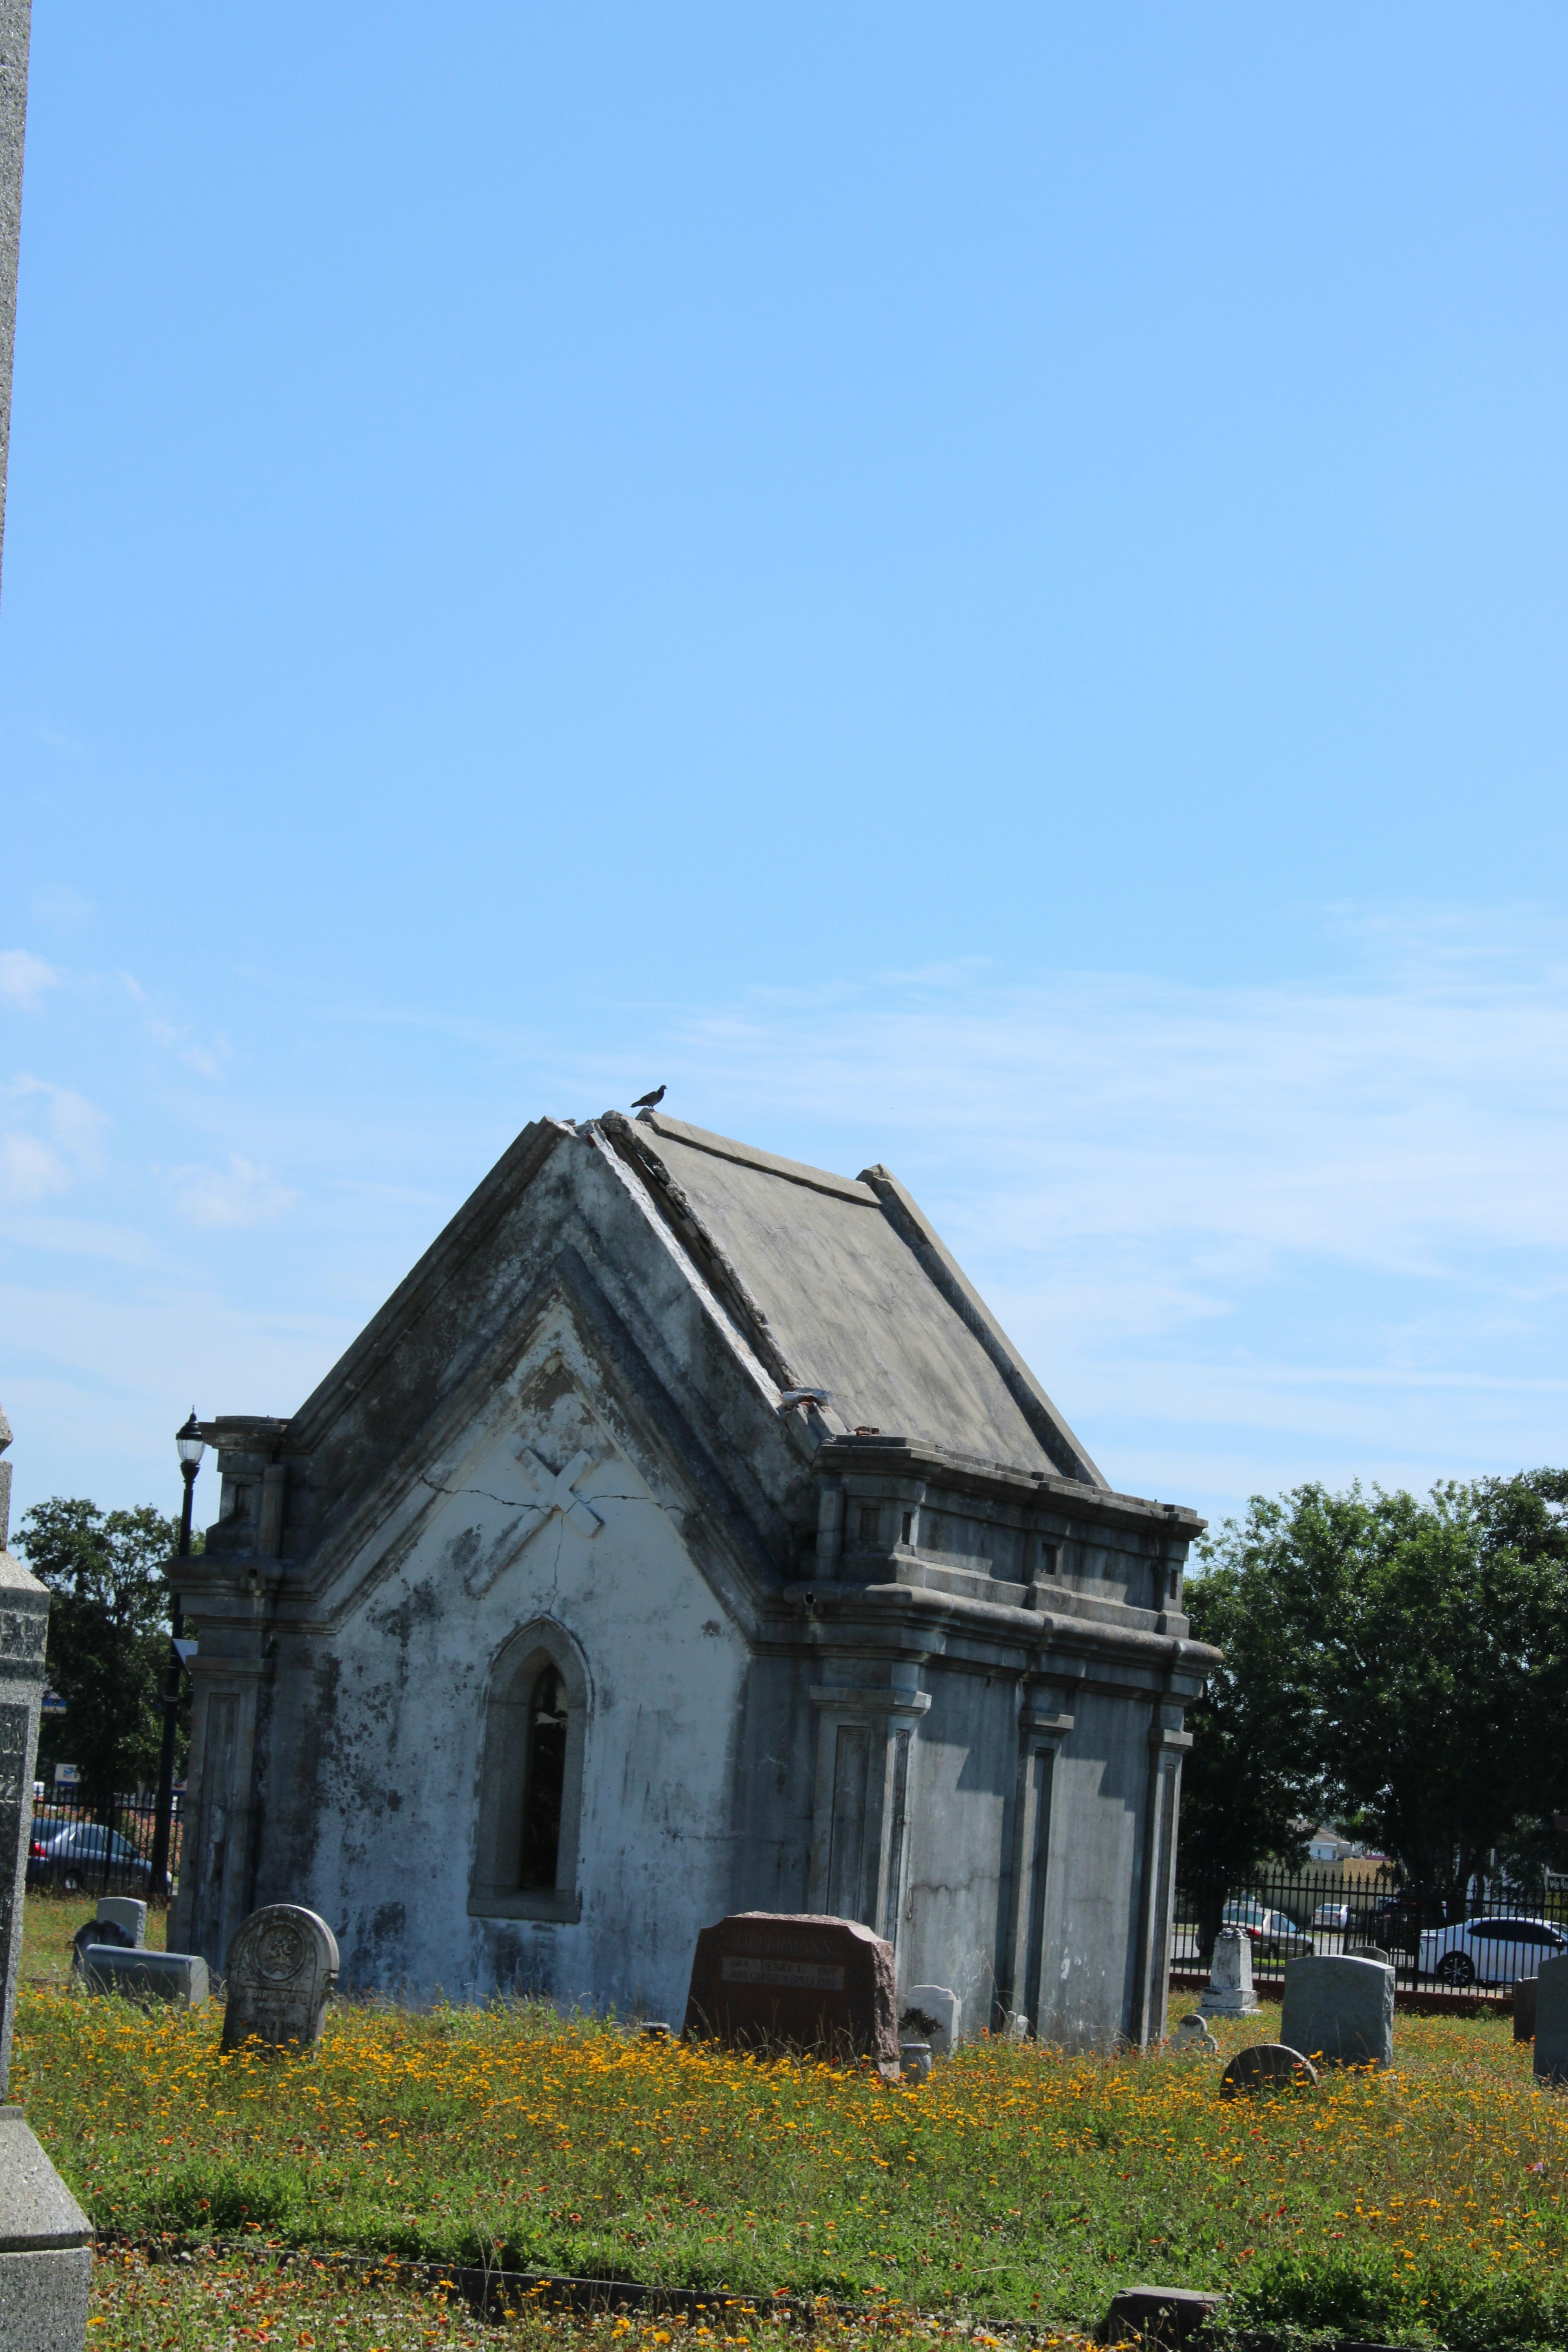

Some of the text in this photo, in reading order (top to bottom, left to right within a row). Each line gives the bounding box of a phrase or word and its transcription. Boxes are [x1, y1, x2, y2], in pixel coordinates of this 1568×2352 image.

[737, 1935, 836, 1954] OPPERMANN
[760, 1960, 791, 1973] HENRY
[782, 1975, 815, 1985] WERNER
